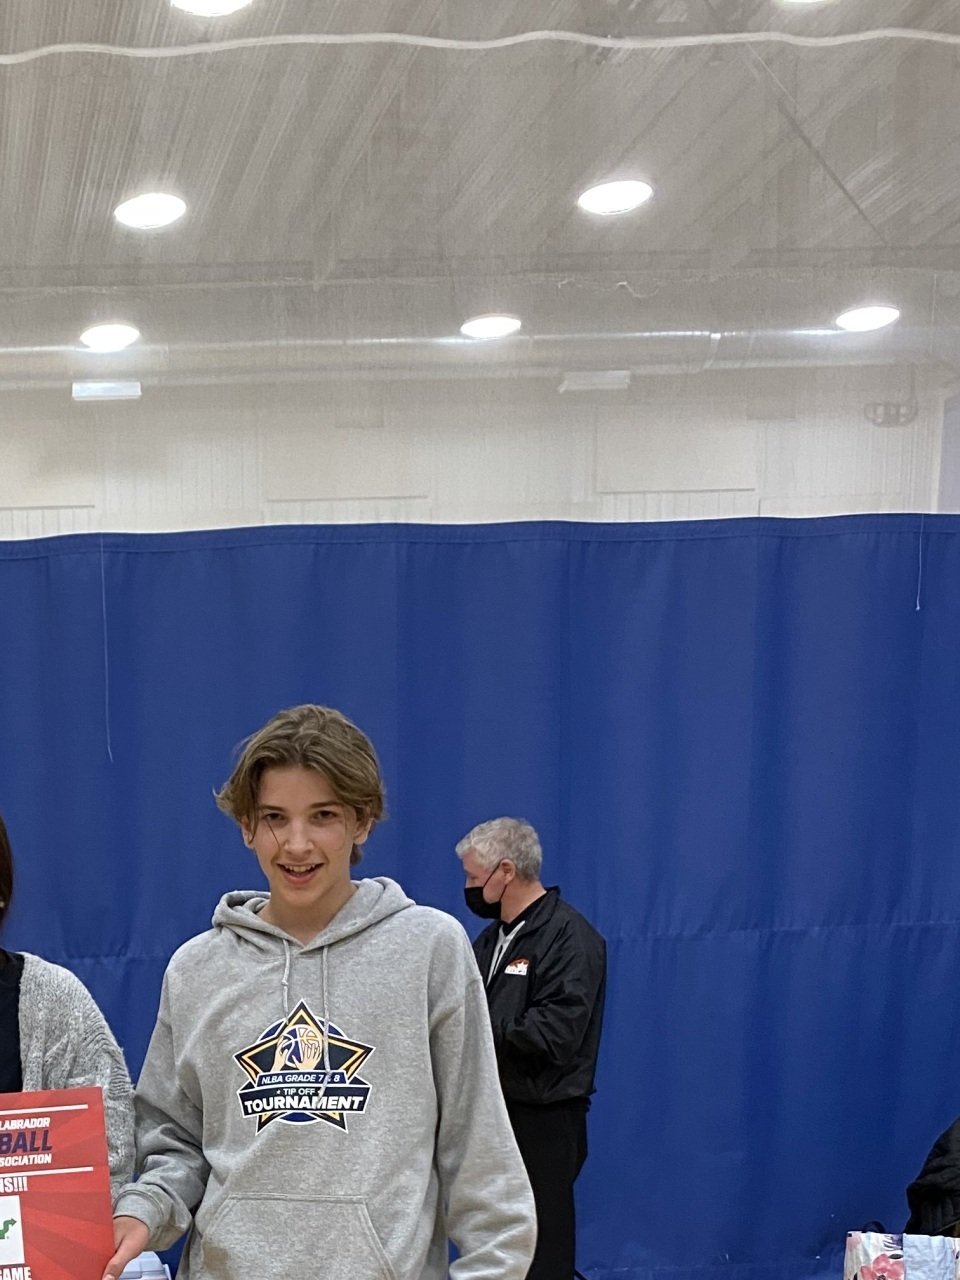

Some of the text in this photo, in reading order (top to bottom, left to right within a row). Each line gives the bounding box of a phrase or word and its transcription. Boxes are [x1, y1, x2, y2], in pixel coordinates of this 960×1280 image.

[261, 1074, 340, 1085] NLBA GRADE 7 8
[244, 1095, 364, 1113] TOURNAMENT
